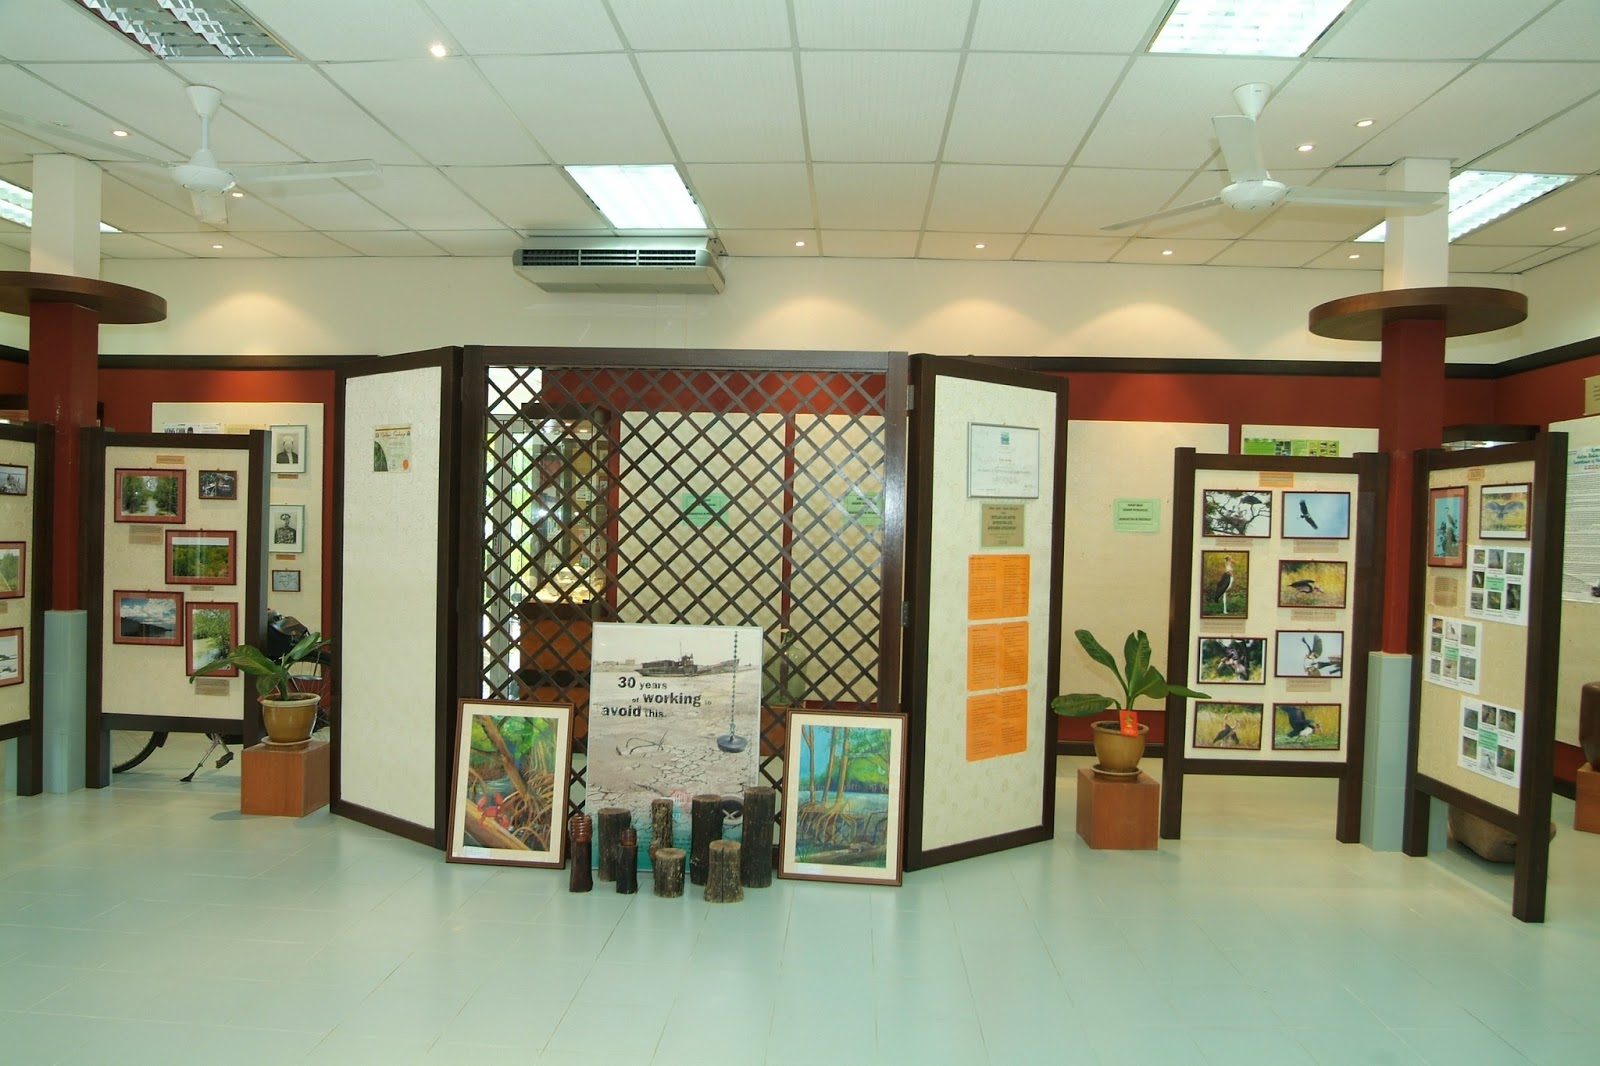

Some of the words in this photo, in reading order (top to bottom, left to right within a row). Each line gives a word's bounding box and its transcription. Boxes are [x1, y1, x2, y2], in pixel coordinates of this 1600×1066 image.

[617, 676, 636, 689] 30
[639, 682, 667, 690] years
[642, 692, 702, 707] working
[602, 705, 641, 717] avoid
[644, 709, 667, 718] this.
